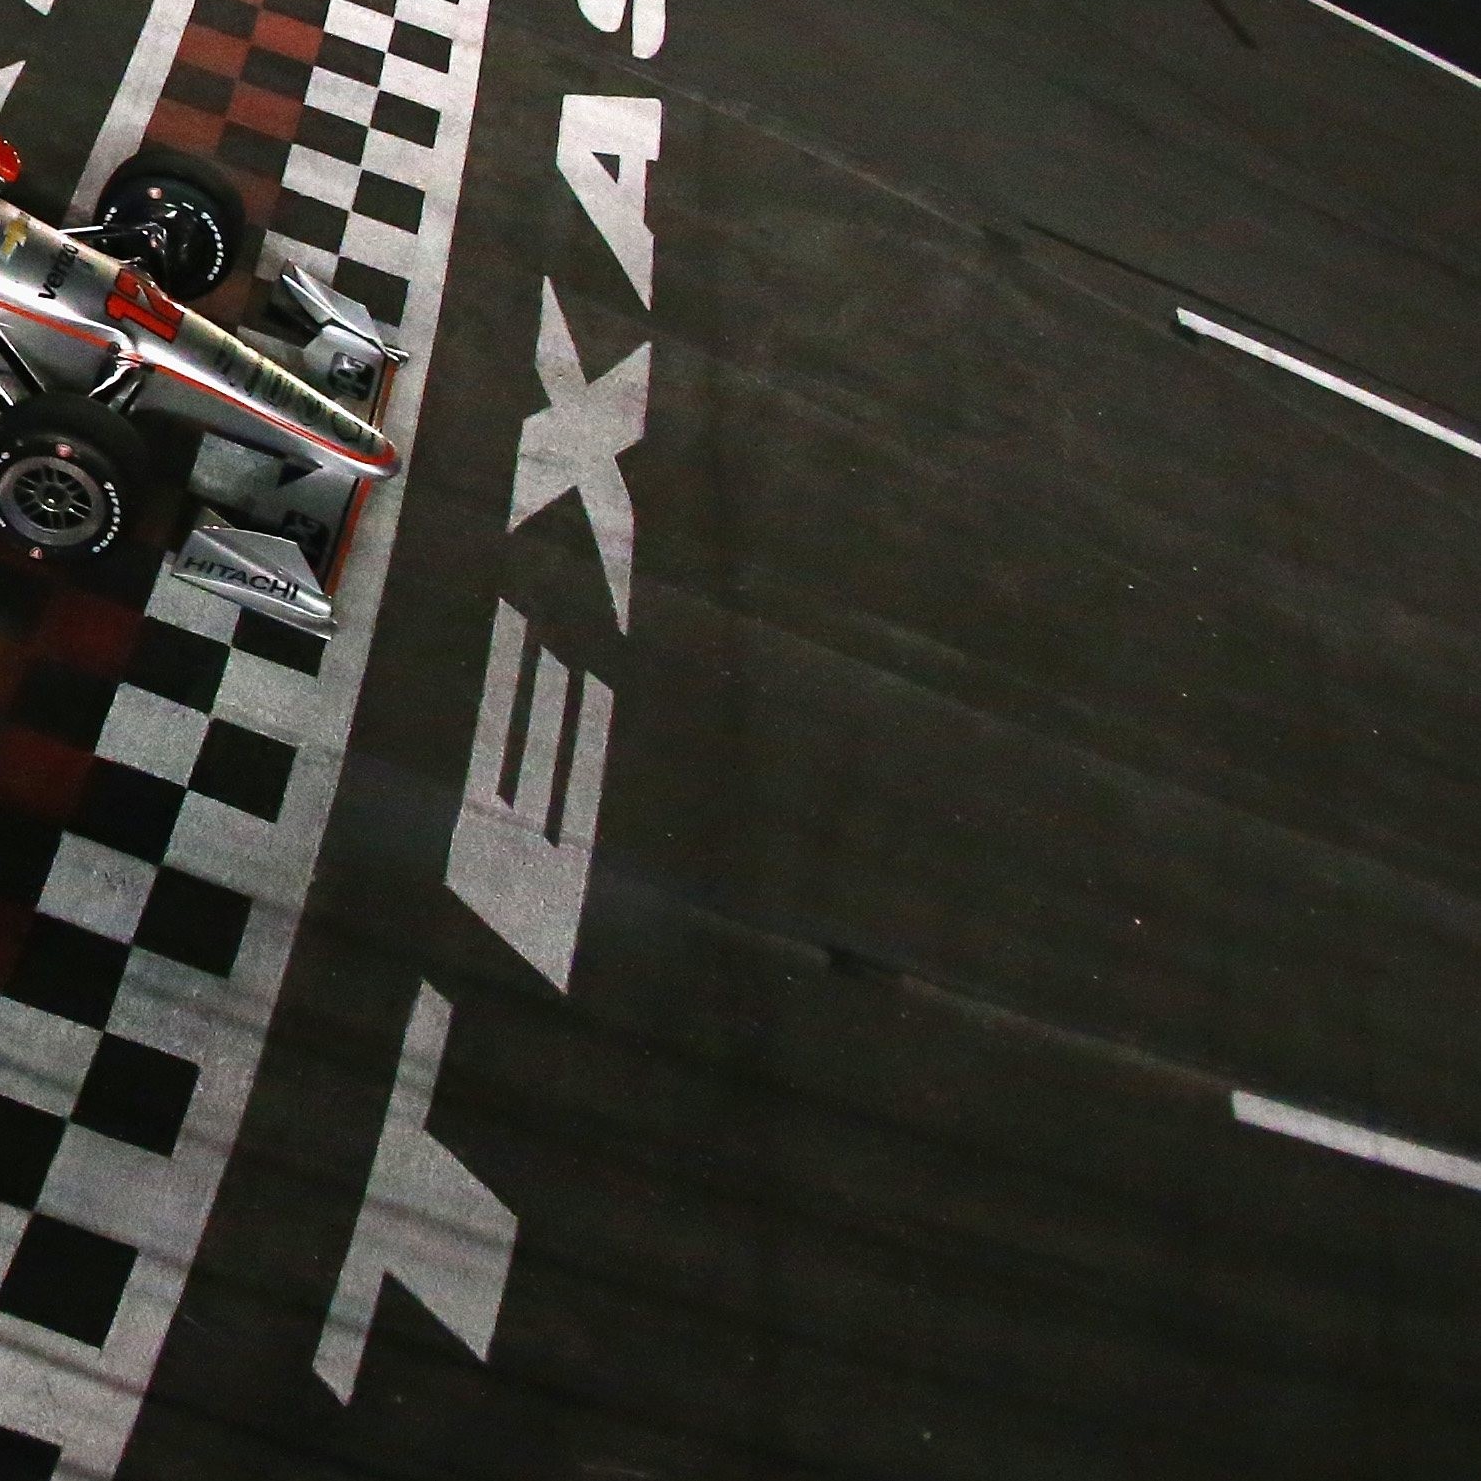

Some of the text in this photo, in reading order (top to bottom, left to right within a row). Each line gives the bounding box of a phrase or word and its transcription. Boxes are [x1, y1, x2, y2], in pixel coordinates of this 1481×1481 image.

[38, 242, 79, 300] verizo
[105, 268, 185, 344] 12
[183, 555, 300, 602] HITACHI
